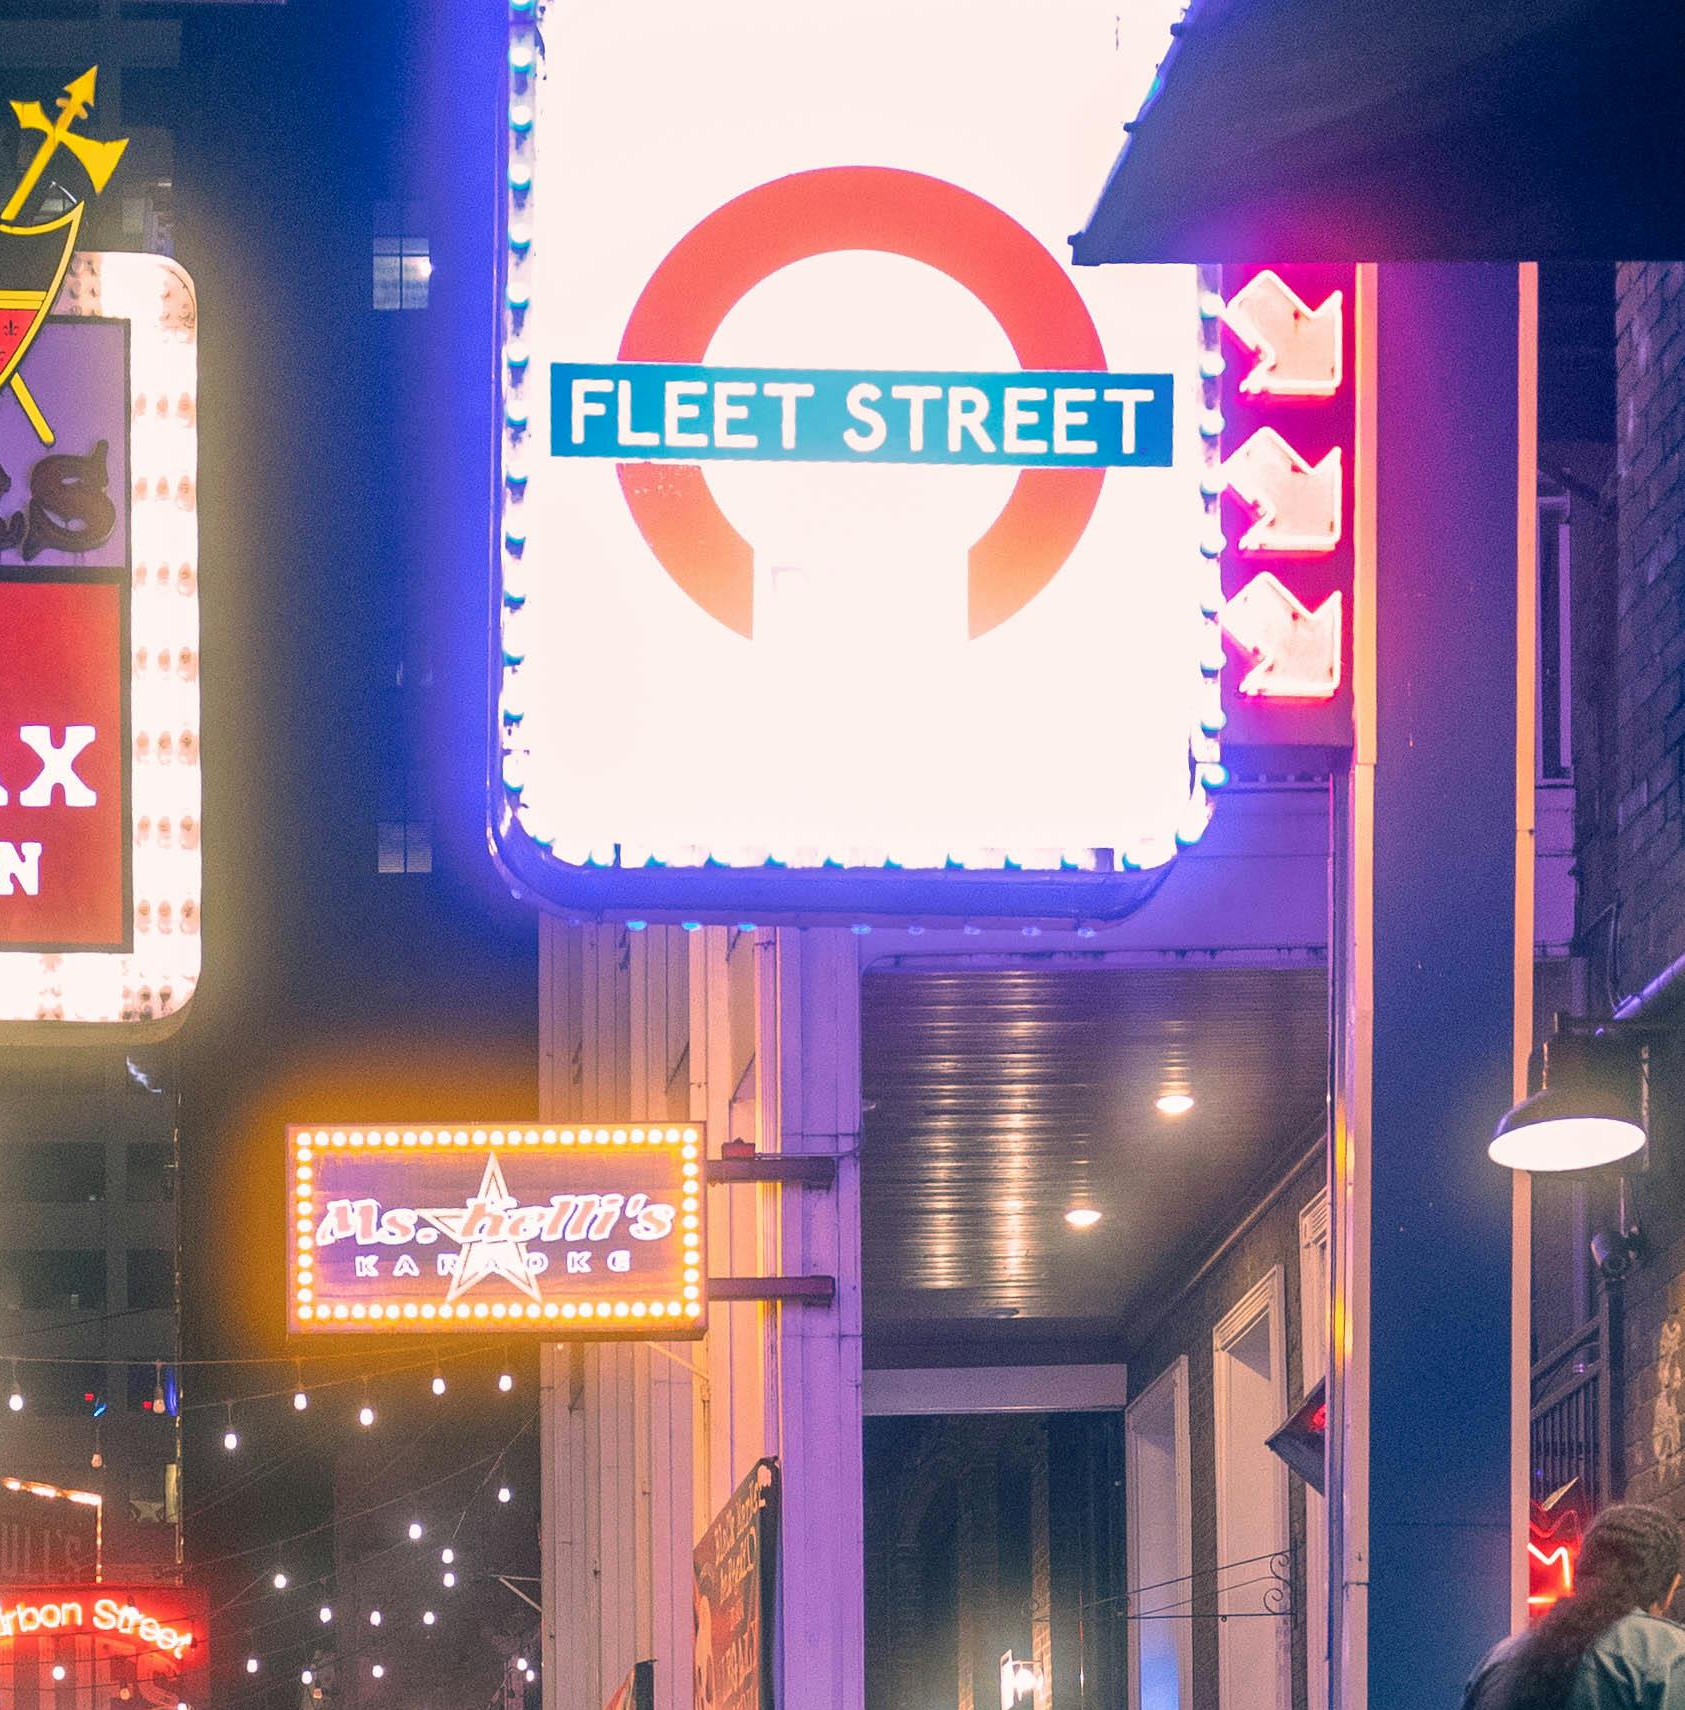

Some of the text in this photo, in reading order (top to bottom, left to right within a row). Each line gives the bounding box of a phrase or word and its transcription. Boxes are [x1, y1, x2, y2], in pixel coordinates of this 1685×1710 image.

[570, 378, 1157, 457] FLEET STREET
[316, 1197, 439, 1246] Ms.
[355, 1249, 632, 1278] KARAOKE
[92, 1599, 192, 1660] Street
